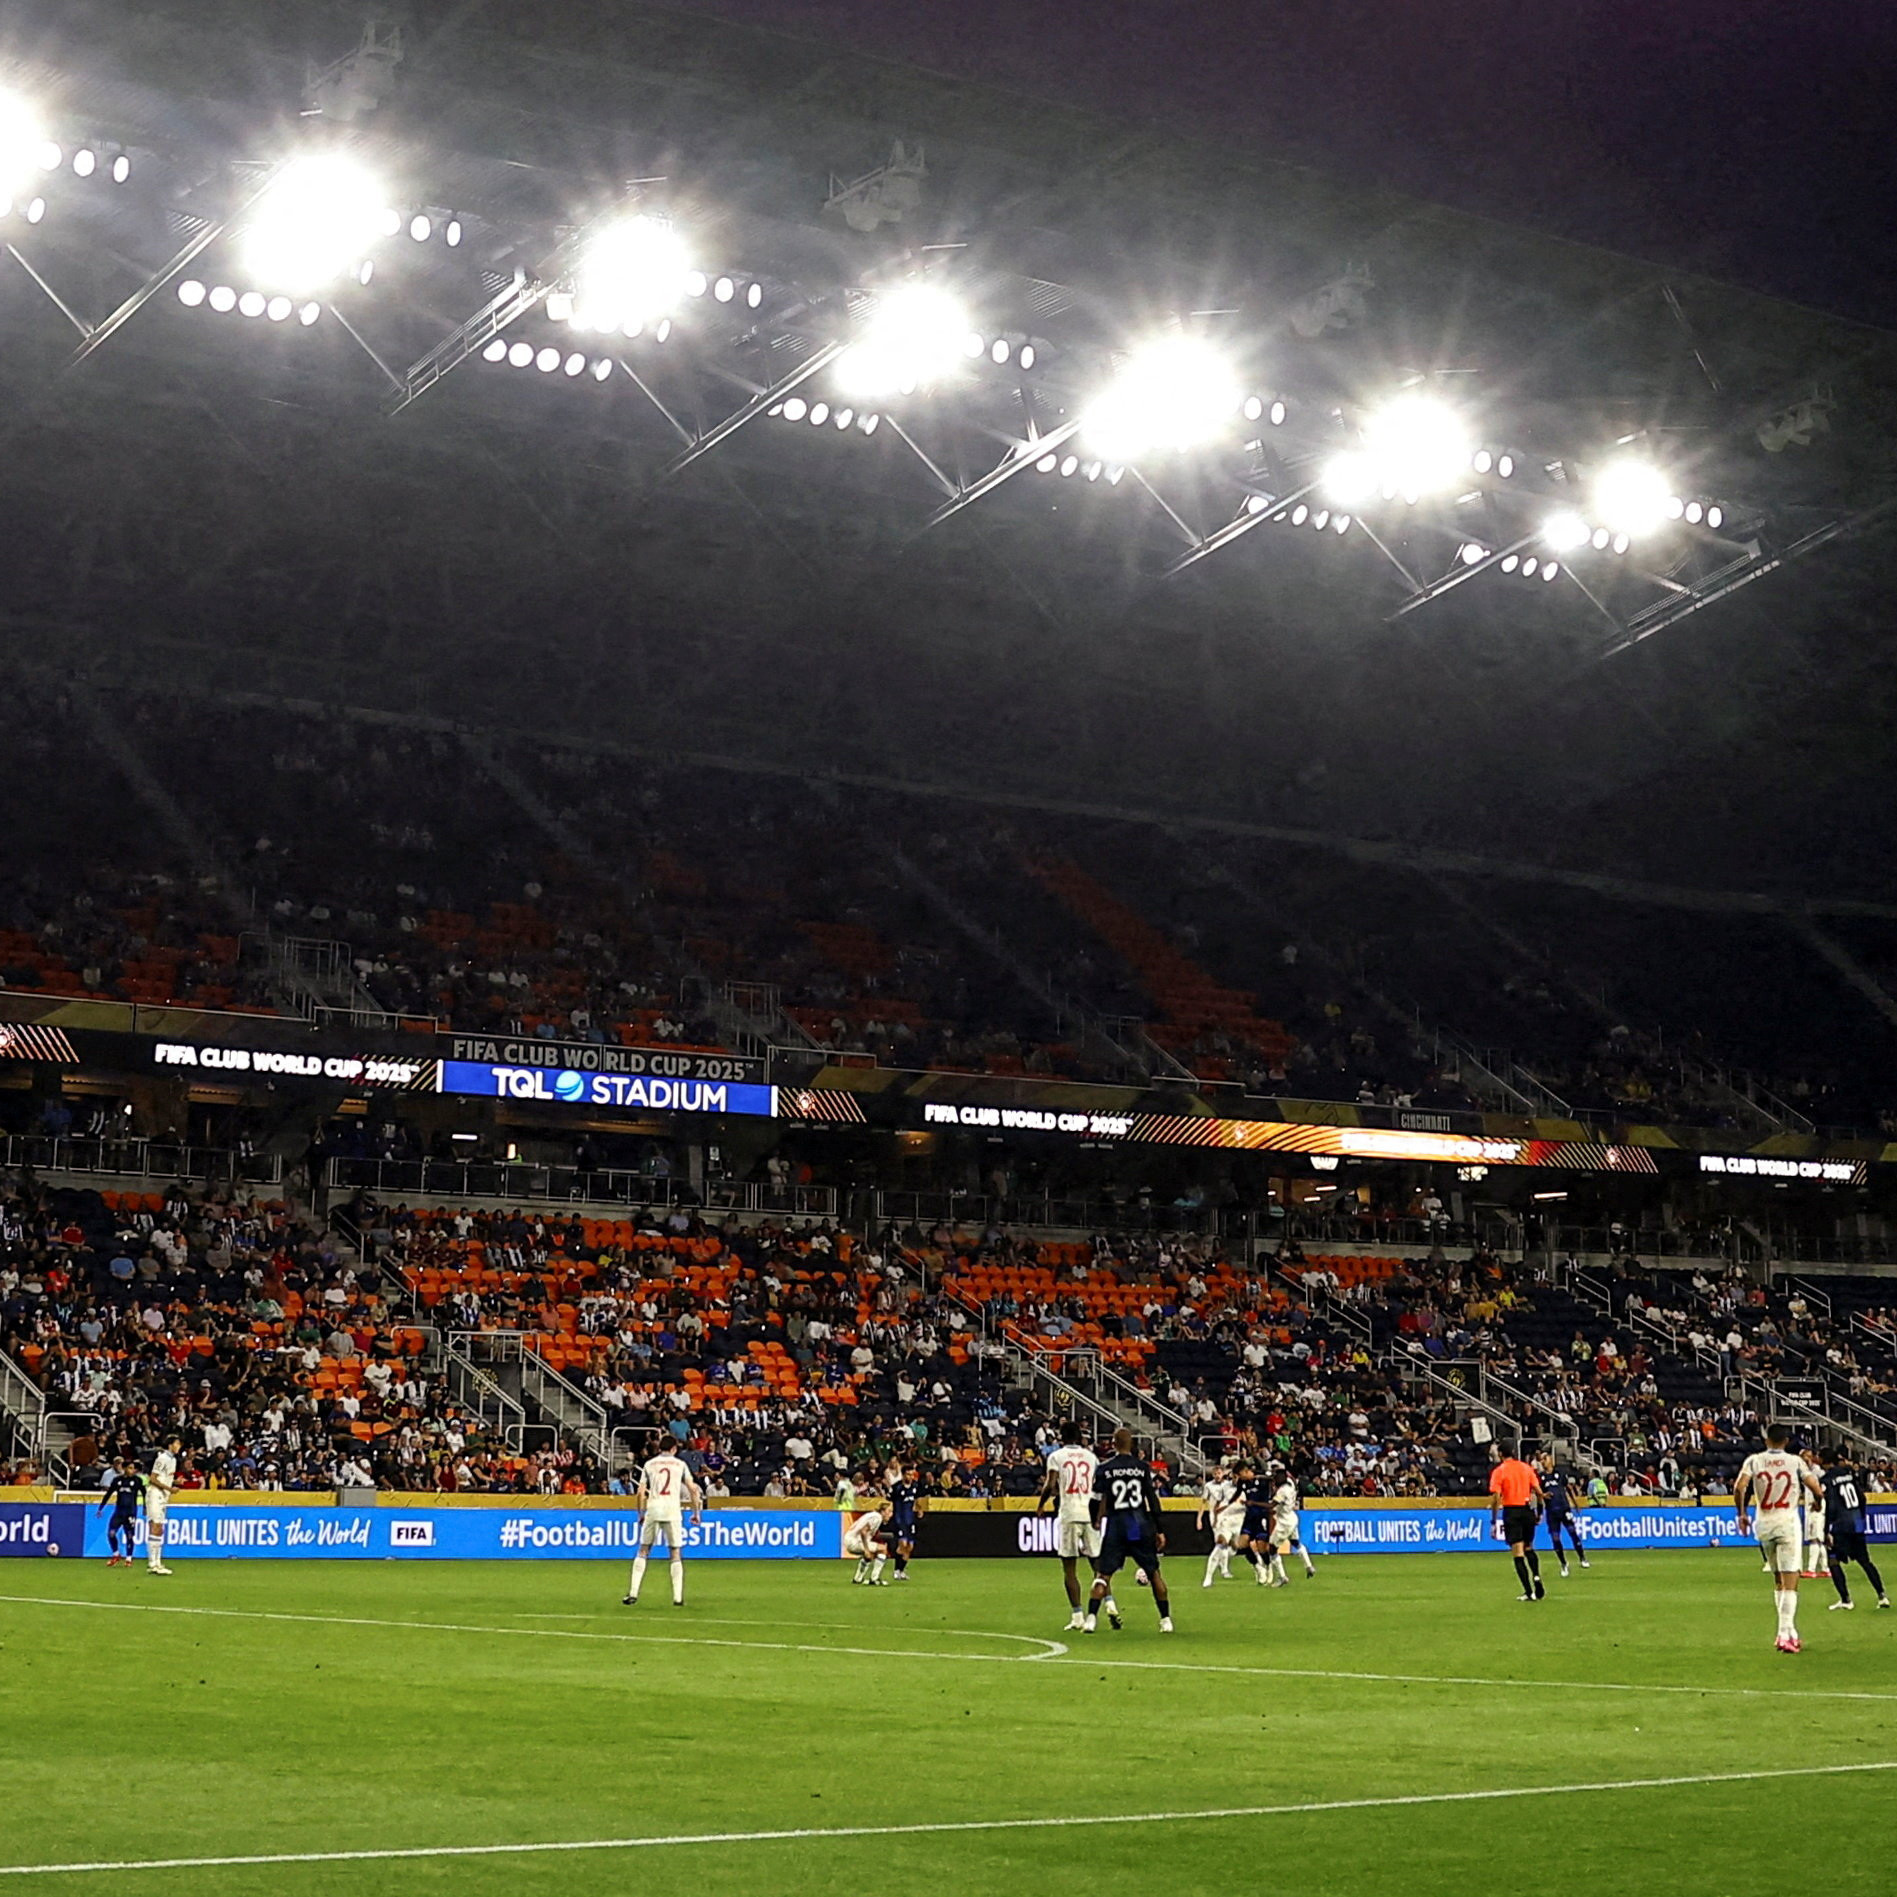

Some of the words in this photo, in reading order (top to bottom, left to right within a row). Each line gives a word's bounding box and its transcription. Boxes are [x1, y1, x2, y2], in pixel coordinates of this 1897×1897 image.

[154, 1044, 197, 1065] FIFA
[200, 1048, 251, 1070] CLUB
[253, 1052, 322, 1076] WORLD
[324, 1057, 363, 1078] CUP
[454, 1040, 499, 1063] FIFA
[504, 1044, 558, 1066] CLUB
[563, 1049, 645, 1073] WORLD
[650, 1056, 694, 1077] CUP
[492, 1067, 553, 1100] TQL
[591, 1076, 727, 1112] STADIUM
[925, 1104, 959, 1124] FIFA
[960, 1107, 1000, 1126] CLUB
[1002, 1110, 1056, 1130] WORLD
[1058, 1113, 1088, 1132] CUP
[1401, 1113, 1451, 1131] CINCINNATI
[1700, 1156, 1726, 1171] FIFA
[1726, 1158, 1756, 1173] CLUB
[1756, 1160, 1796, 1176] WORLD
[1798, 1162, 1822, 1178] CUP
[659, 1468, 671, 1496] 2
[1063, 1461, 1090, 1494] 23
[1757, 1471, 1792, 1509] 22
[1111, 1479, 1143, 1509] 23
[1839, 1483, 1859, 1509] 10
[216, 1519, 279, 1546] UNITES
[283, 1520, 315, 1545] the
[316, 1518, 371, 1548] World
[396, 1527, 427, 1540] FIFA
[1378, 1519, 1421, 1543] UNITES
[1424, 1519, 1445, 1541] the
[1446, 1517, 1483, 1543] World
